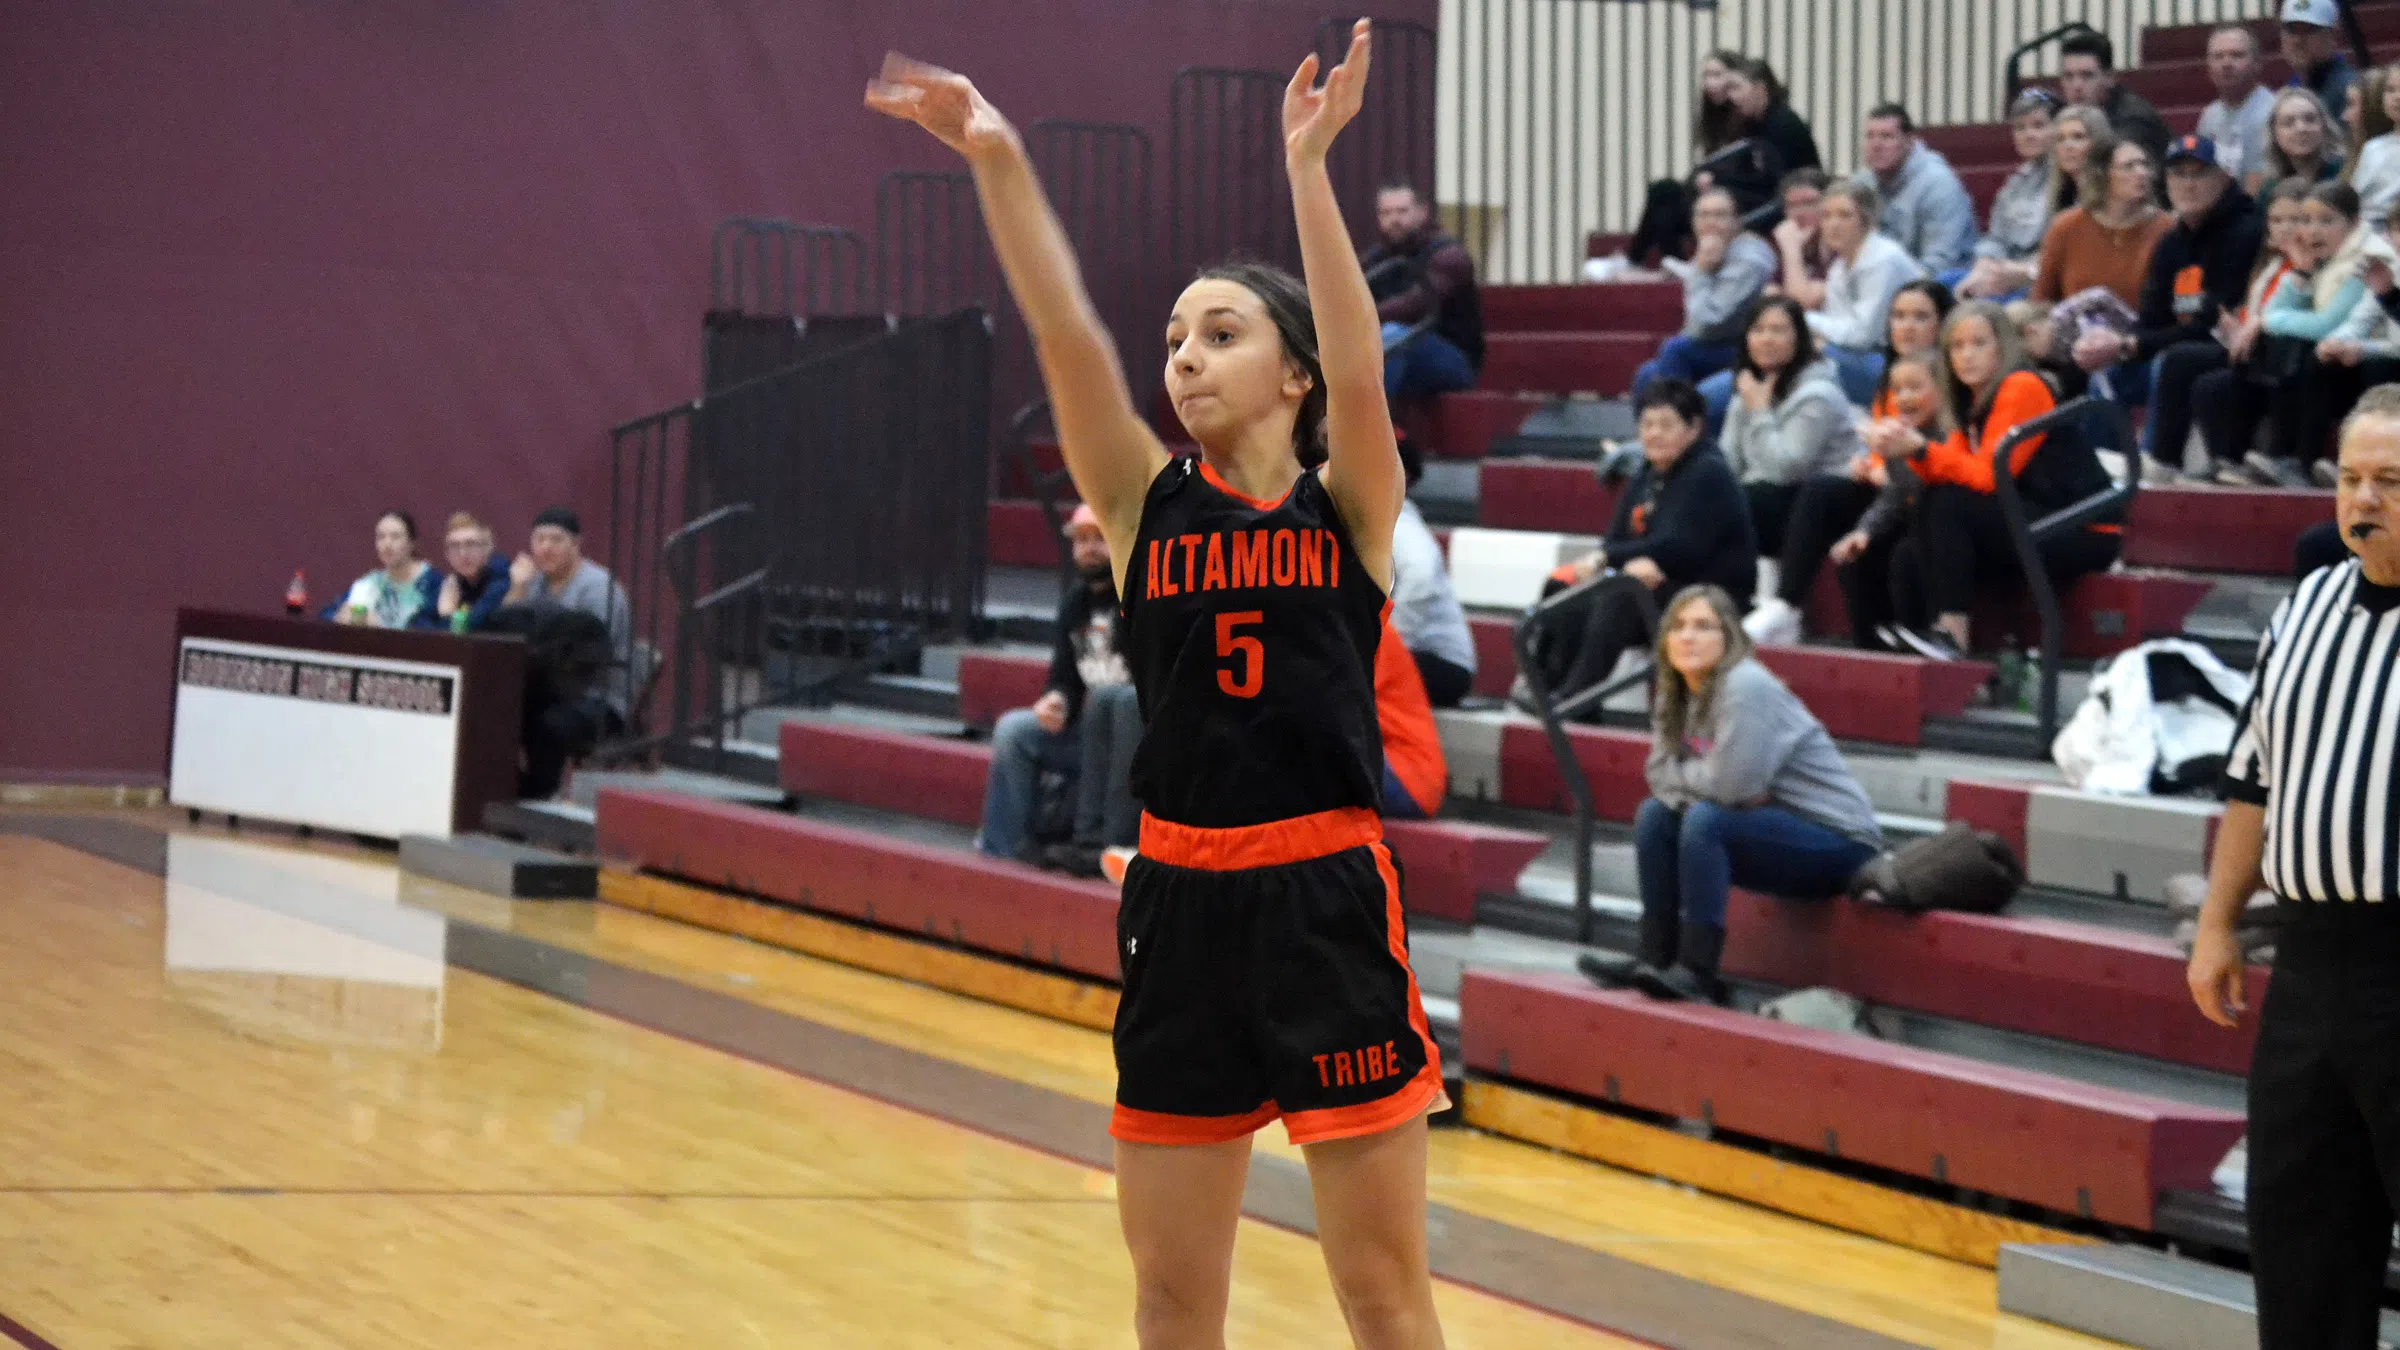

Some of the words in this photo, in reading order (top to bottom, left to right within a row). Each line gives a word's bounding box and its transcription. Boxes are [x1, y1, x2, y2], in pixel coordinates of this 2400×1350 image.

[1146, 527, 1340, 601] ALTAMONT
[1215, 610, 1265, 699] 5
[1312, 1040, 1401, 1088] TRIBE
